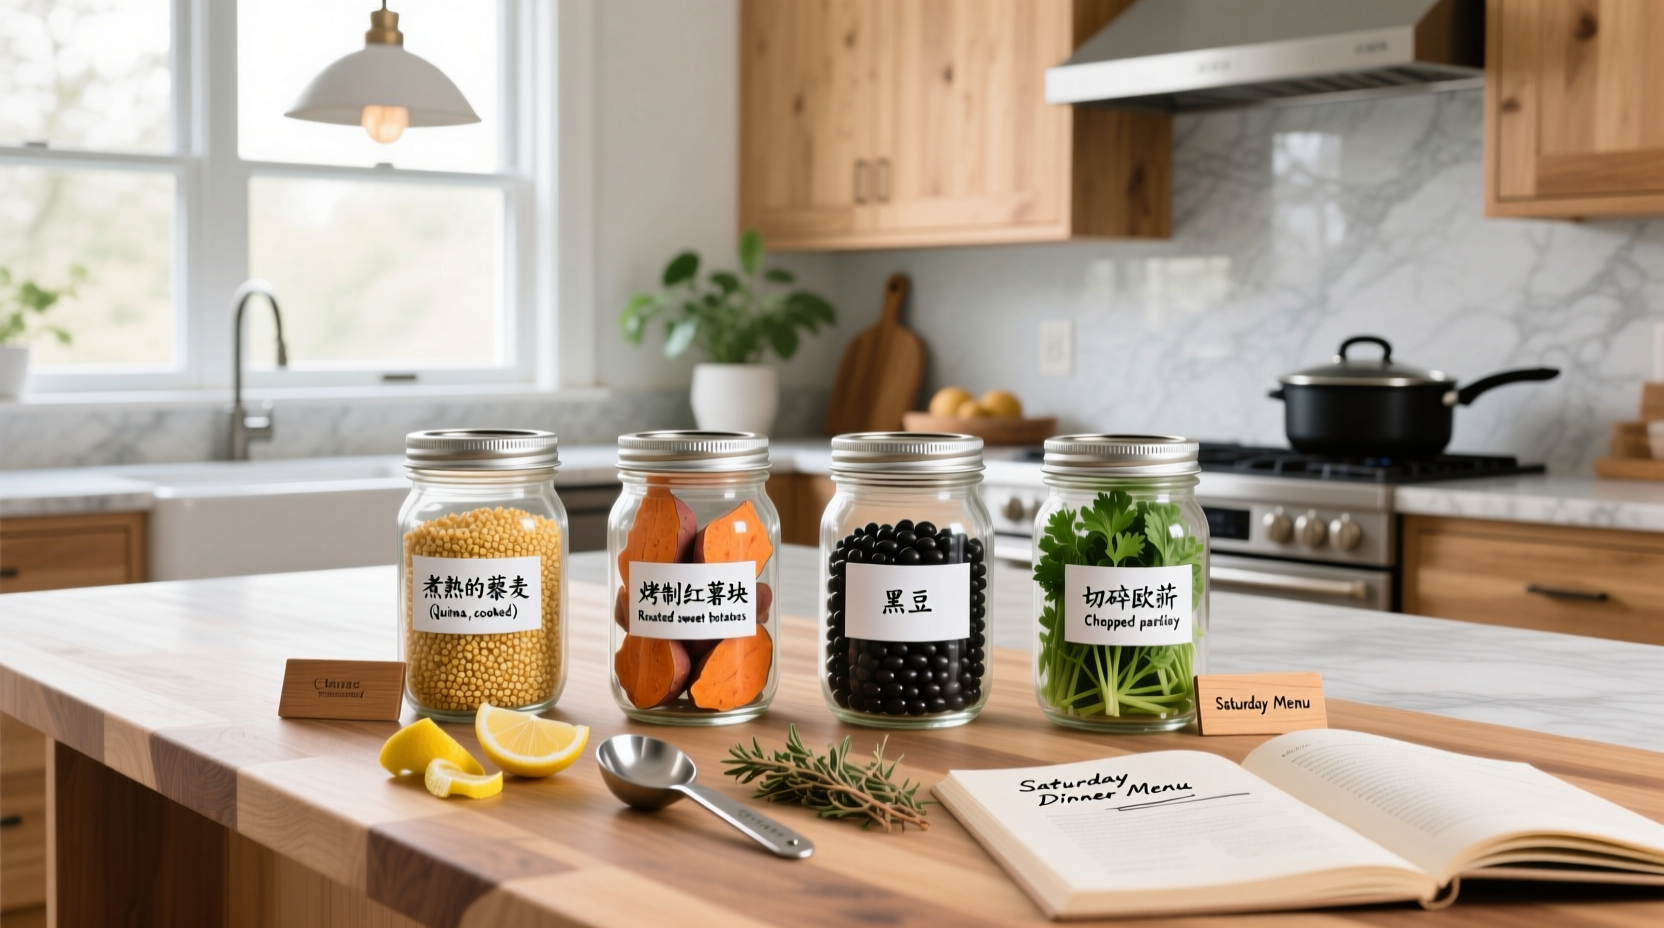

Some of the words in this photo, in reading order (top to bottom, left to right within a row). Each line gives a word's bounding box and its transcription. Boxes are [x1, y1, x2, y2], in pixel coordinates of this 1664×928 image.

[638, 580, 749, 606] 烤制红薯块
[882, 588, 933, 615] 黑豆
[1084, 613, 1136, 632] Chopped
[1215, 695, 1268, 715] Saturday
[1273, 695, 1310, 710] Menu
[1019, 772, 1129, 793] Saturday
[1038, 790, 1117, 807] Dinner
[1126, 780, 1193, 797] Menu
